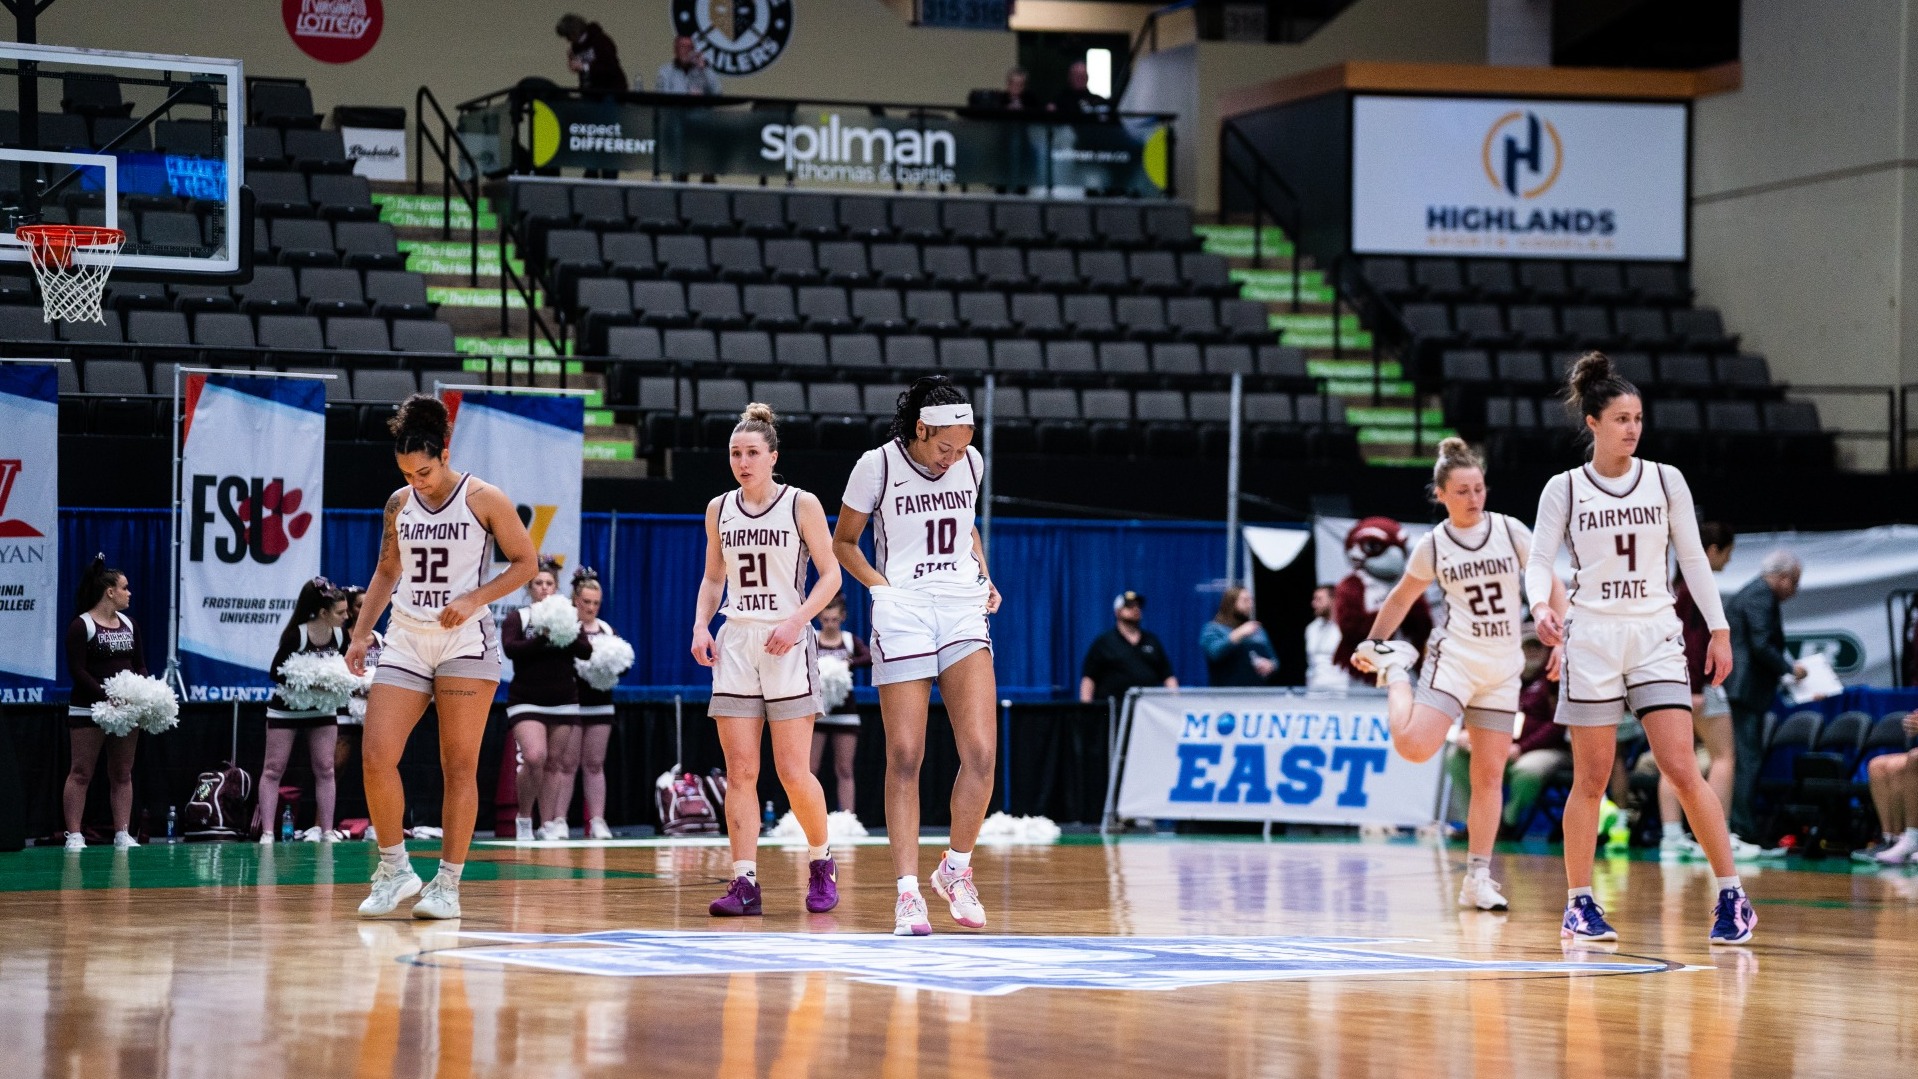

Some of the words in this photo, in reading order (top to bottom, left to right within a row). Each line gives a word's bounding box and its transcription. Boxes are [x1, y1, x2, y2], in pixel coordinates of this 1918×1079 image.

[295, 13, 372, 37] LOTTERY
[569, 122, 621, 138] expect
[760, 113, 957, 172] spilman
[569, 136, 656, 155] DIFFERENT
[798, 162, 876, 183] thomas
[878, 164, 894, 183] &
[1427, 206, 1616, 236] HIGHLANDS
[895, 489, 973, 516] FAIRMONT
[190, 474, 284, 565] FSU
[400, 522, 470, 541] FAIRMONT
[1579, 506, 1662, 532] FAIRMONT
[721, 529, 790, 549] FAIRMONT
[925, 517, 957, 556] 10
[411, 547, 448, 583] 32
[1614, 533, 1636, 572] 4
[738, 552, 769, 588] 21
[1442, 557, 1514, 584] FAIRMONT
[202, 596, 266, 610] FROSTBURG
[1464, 581, 1506, 616] 22
[1601, 580, 1648, 600] STATE
[219, 612, 281, 624] UNIVERSITY
[1472, 620, 1512, 638] STATE
[1182, 711, 1391, 742] MOUNTAIN
[1168, 744, 1389, 808] EAST
